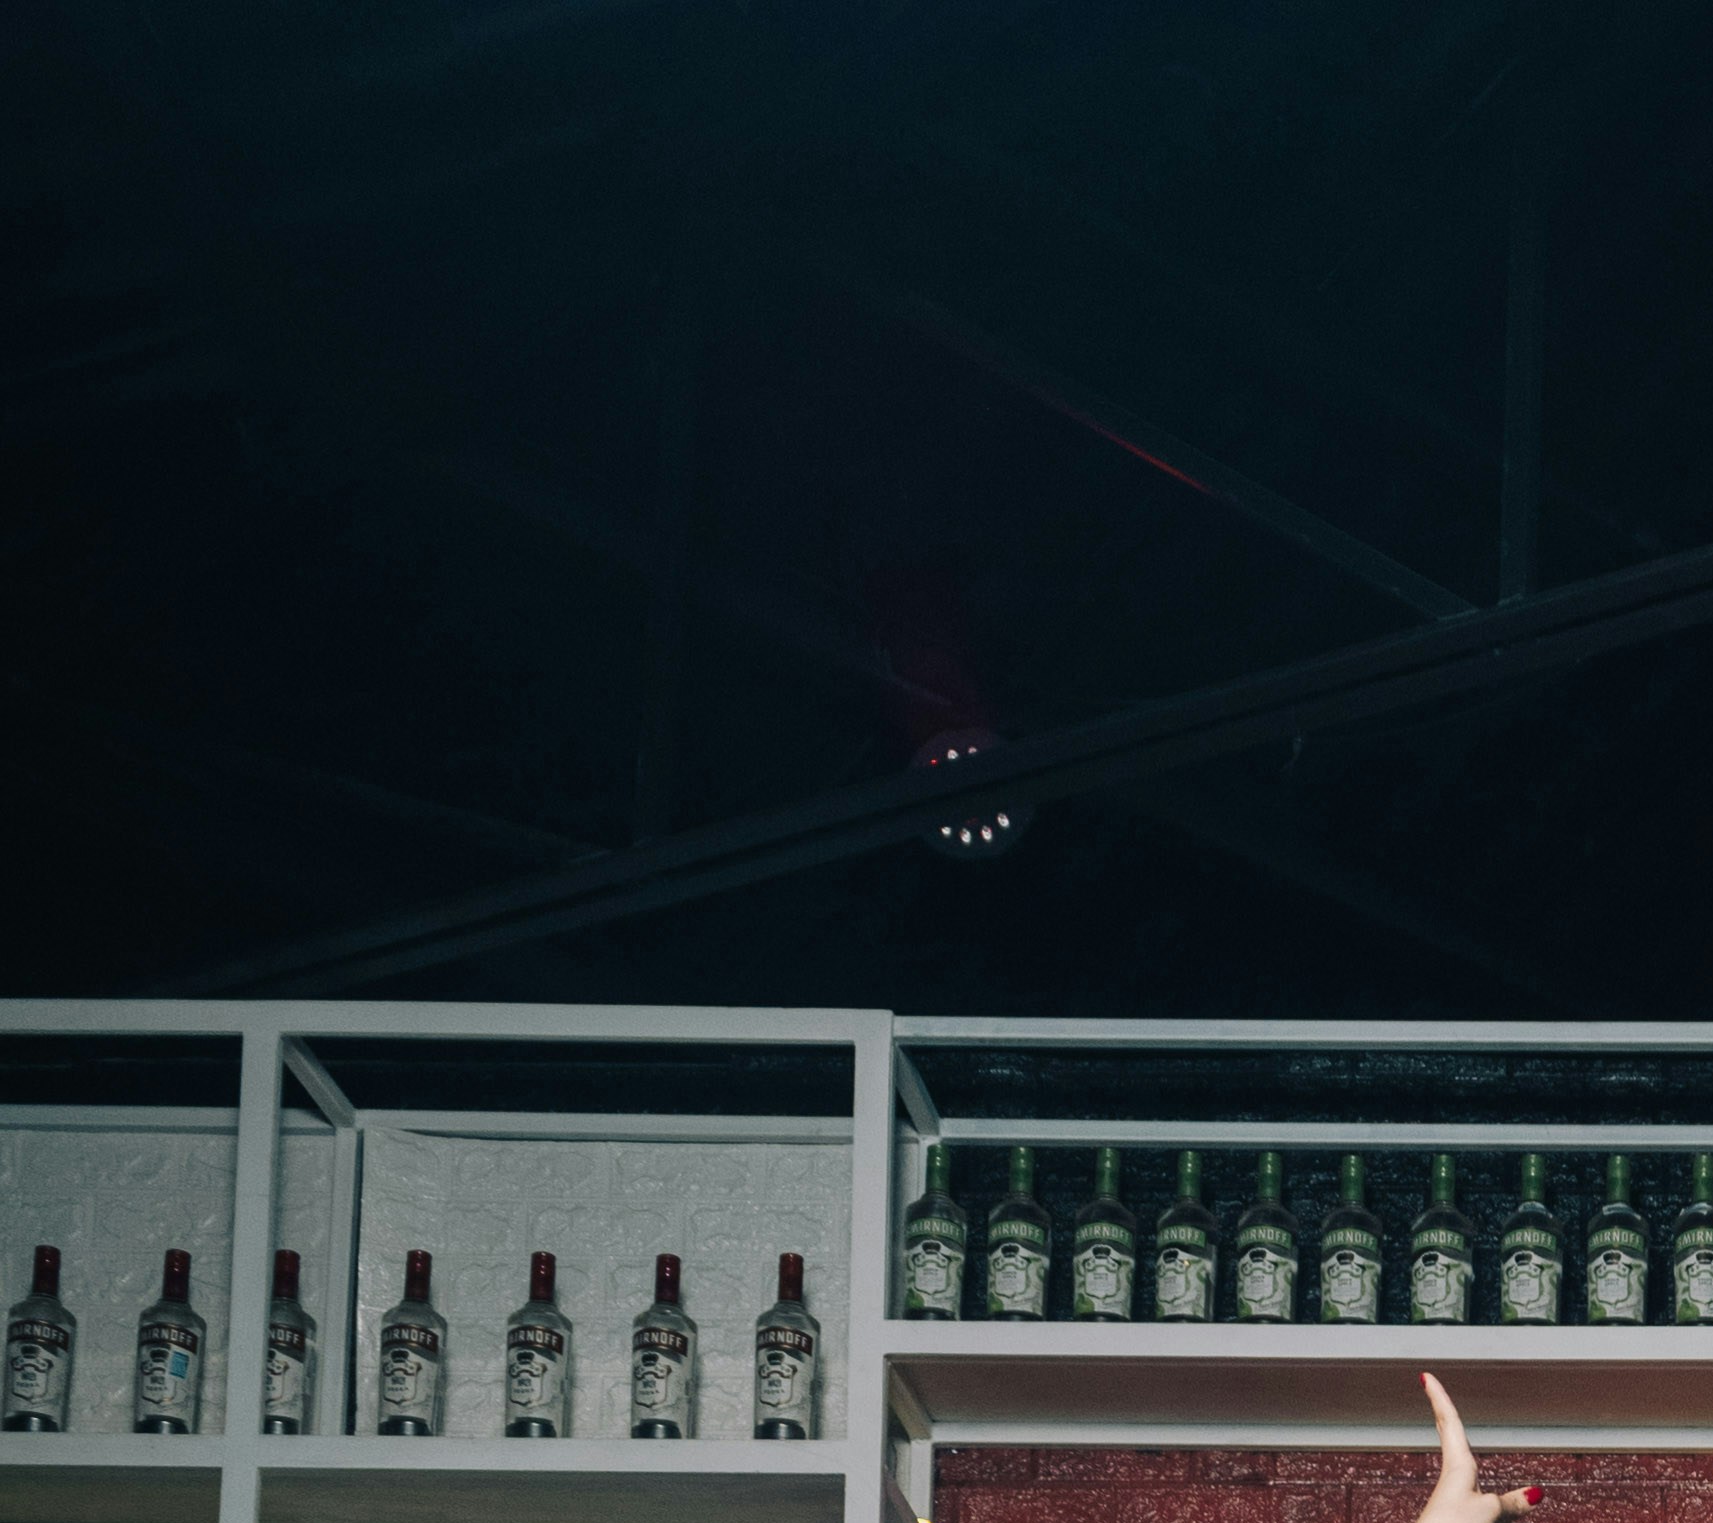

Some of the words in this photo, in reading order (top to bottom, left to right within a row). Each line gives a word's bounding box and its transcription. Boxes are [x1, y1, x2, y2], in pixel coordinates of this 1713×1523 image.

[991, 1223, 1040, 1239] MIRNOFF
[1239, 1228, 1287, 1244] MIRNOFF
[1325, 1230, 1375, 1247] MIRNOFF
[1504, 1230, 1553, 1247] MIRNOFF
[11, 1322, 66, 1344] MIRNOFF
[140, 1326, 194, 1347] MIRNOFF
[382, 1328, 434, 1346] MIRNOFF
